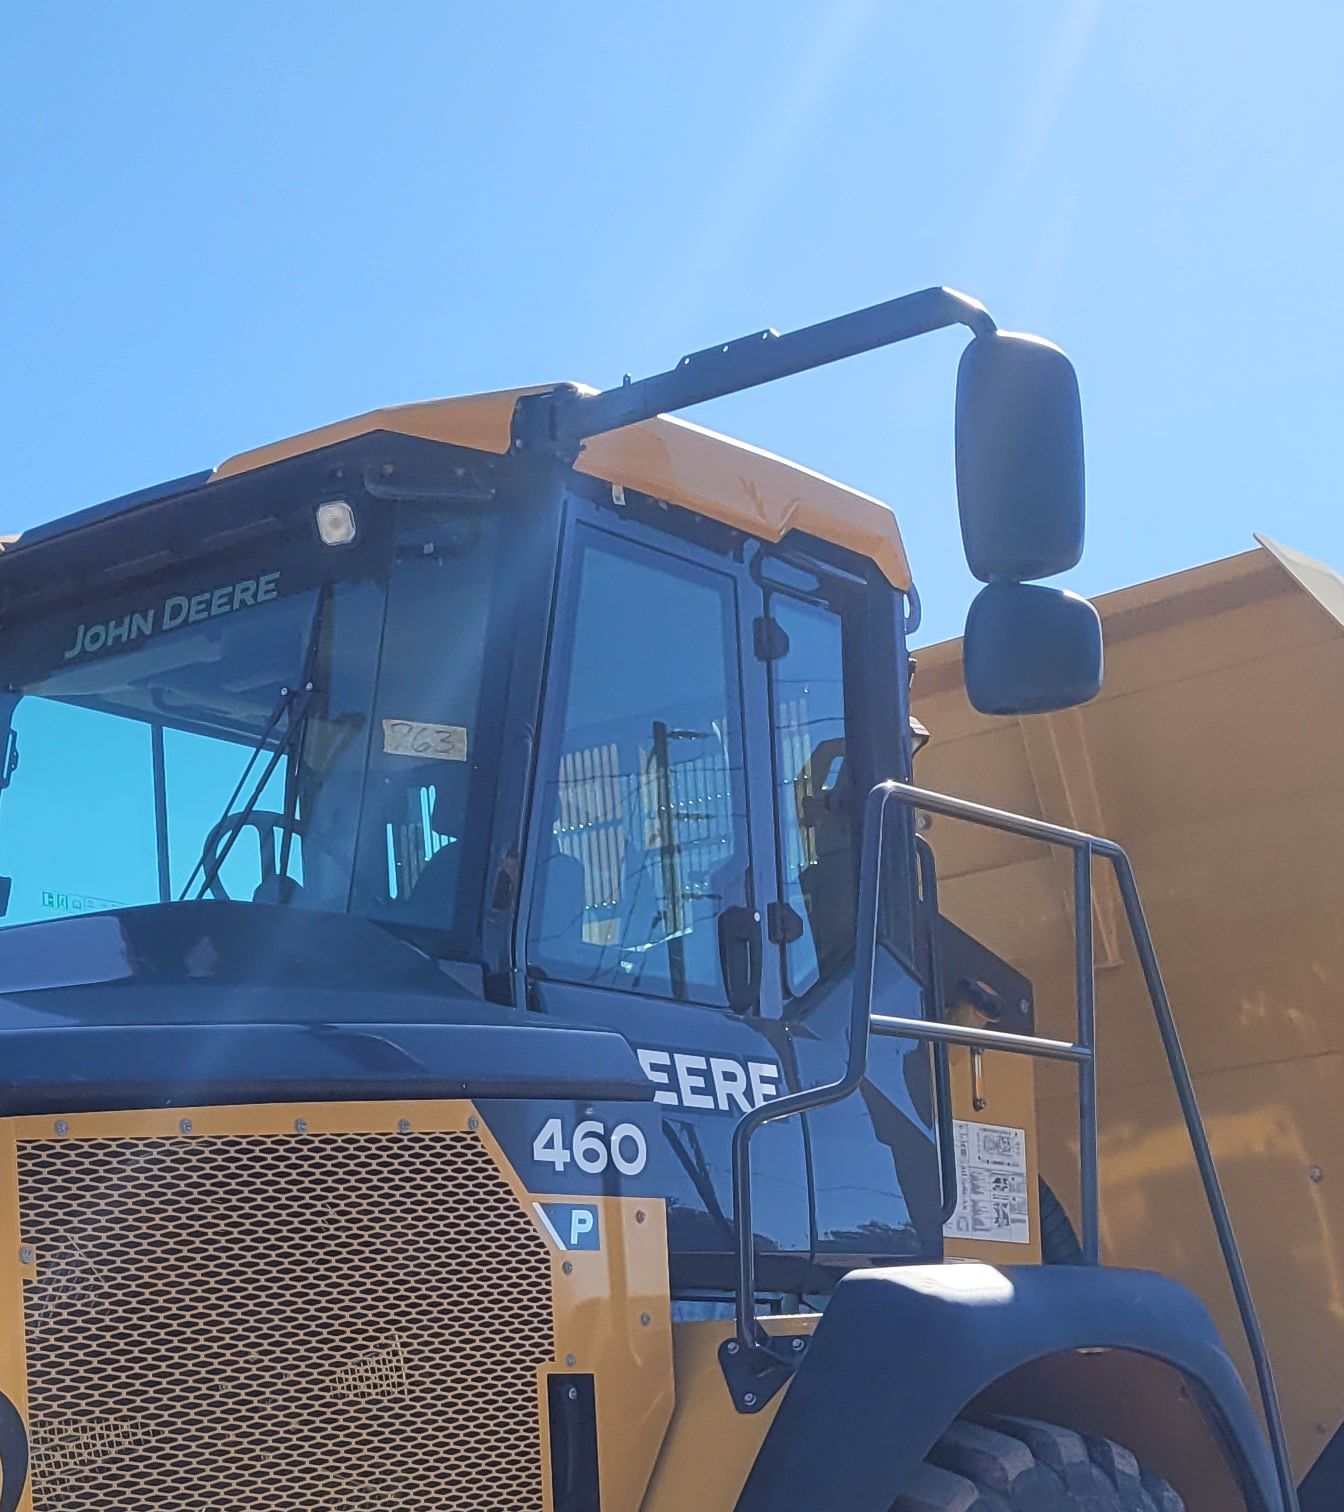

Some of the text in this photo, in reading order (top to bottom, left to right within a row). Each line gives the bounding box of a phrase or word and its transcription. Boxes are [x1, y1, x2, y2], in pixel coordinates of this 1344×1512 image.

[64, 571, 281, 660] JOHN DEERE
[636, 1048, 779, 1113] EERE
[532, 1118, 647, 1176] 460
[570, 1209, 594, 1244] P
